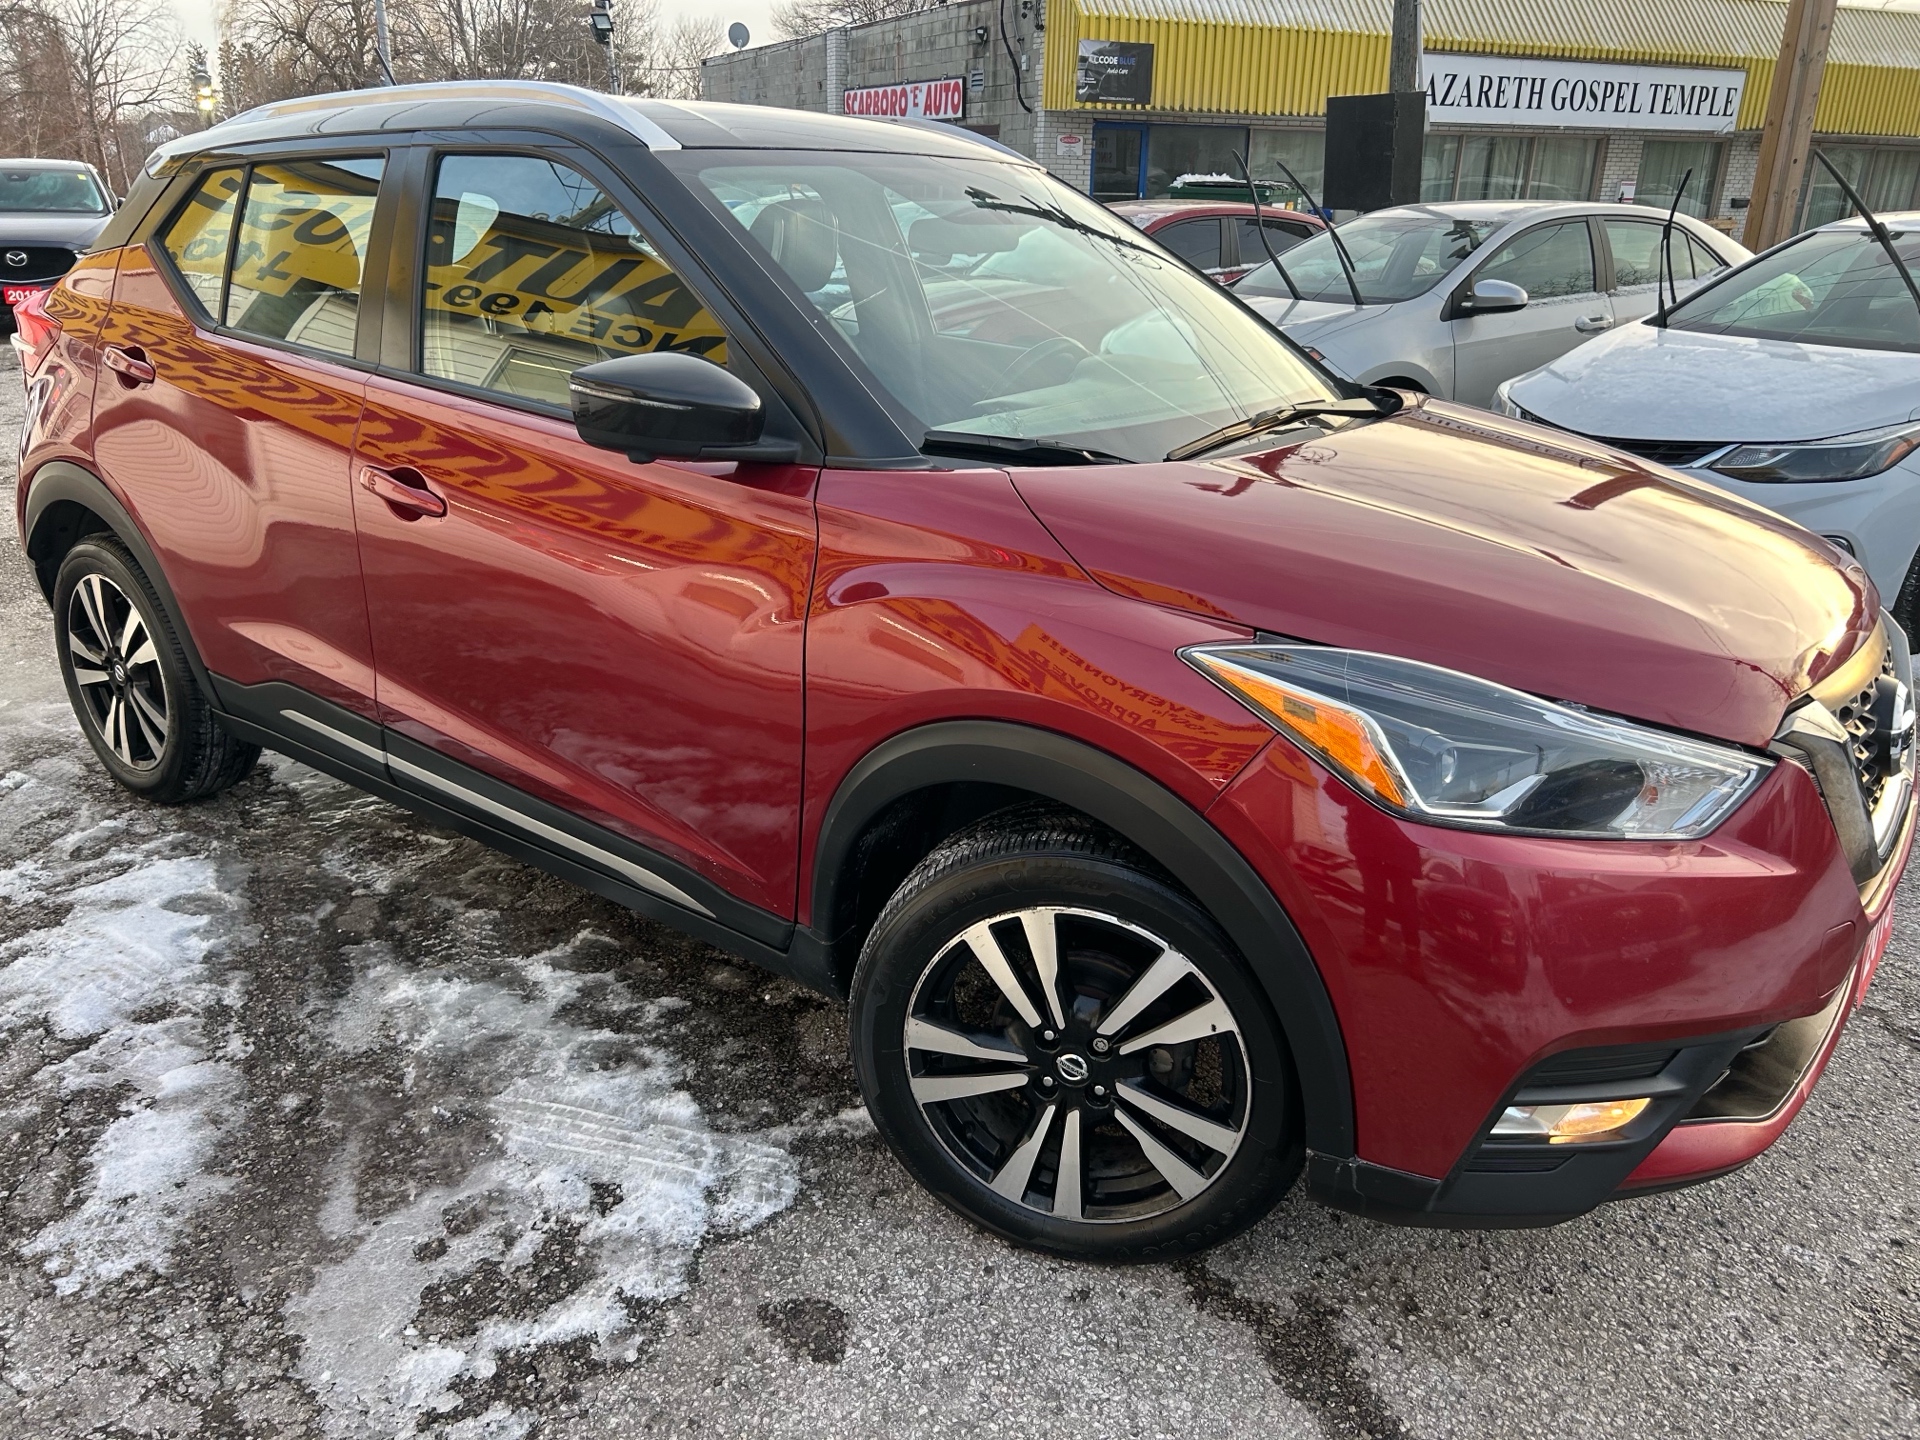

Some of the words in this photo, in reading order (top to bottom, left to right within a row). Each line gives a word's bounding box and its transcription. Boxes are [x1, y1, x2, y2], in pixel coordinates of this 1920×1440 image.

[1119, 57, 1136, 66] BLUE
[844, 86, 908, 117] SCARBORO
[923, 81, 962, 117] AUTO
[1425, 72, 1548, 111] AZARETH
[1551, 78, 1642, 114] GOSPEL
[1647, 83, 1739, 118] TEMPLE
[1059, 1060, 1085, 1077] NISSAN
